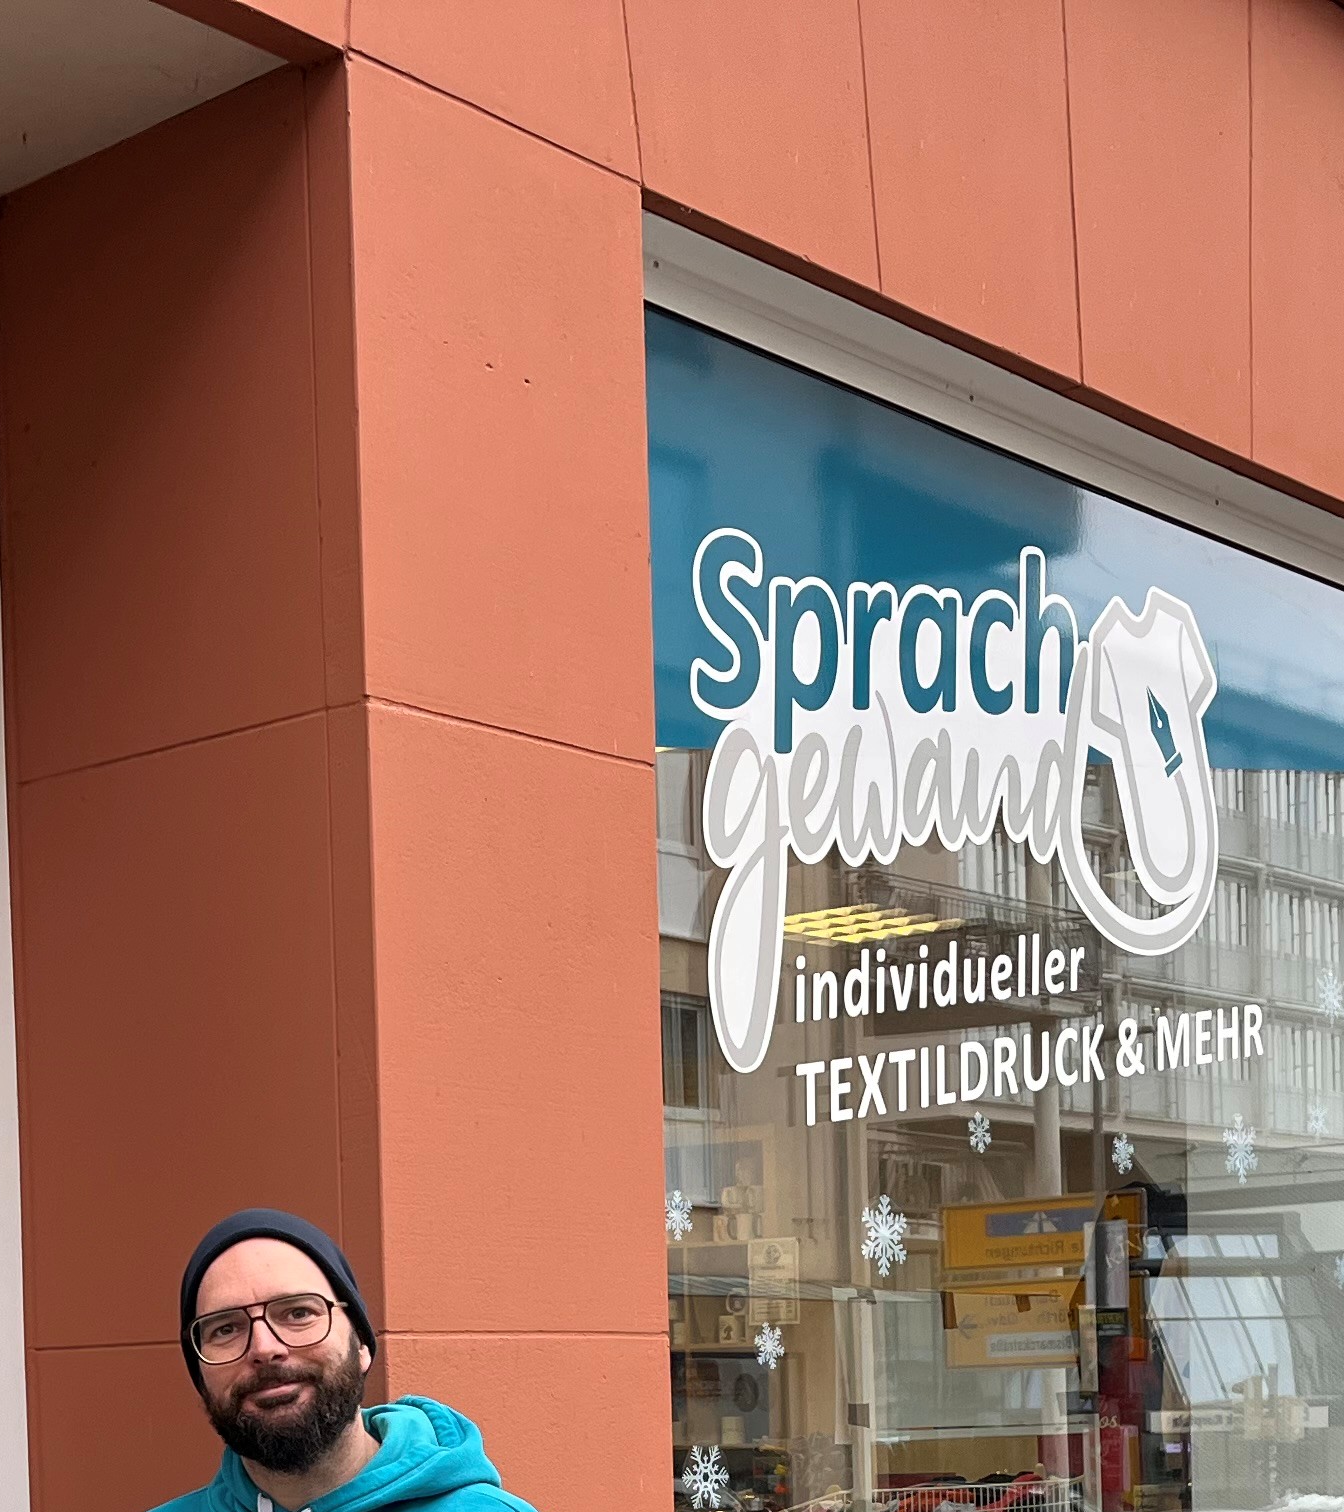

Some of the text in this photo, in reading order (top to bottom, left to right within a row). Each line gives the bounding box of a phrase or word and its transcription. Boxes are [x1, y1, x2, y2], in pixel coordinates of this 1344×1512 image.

[697, 533, 1079, 754] Sprach
[707, 640, 1088, 1071] gewand
[795, 933, 1086, 1023] individueller
[796, 1003, 1264, 1128] TEXTILDRUCK & MEHR
